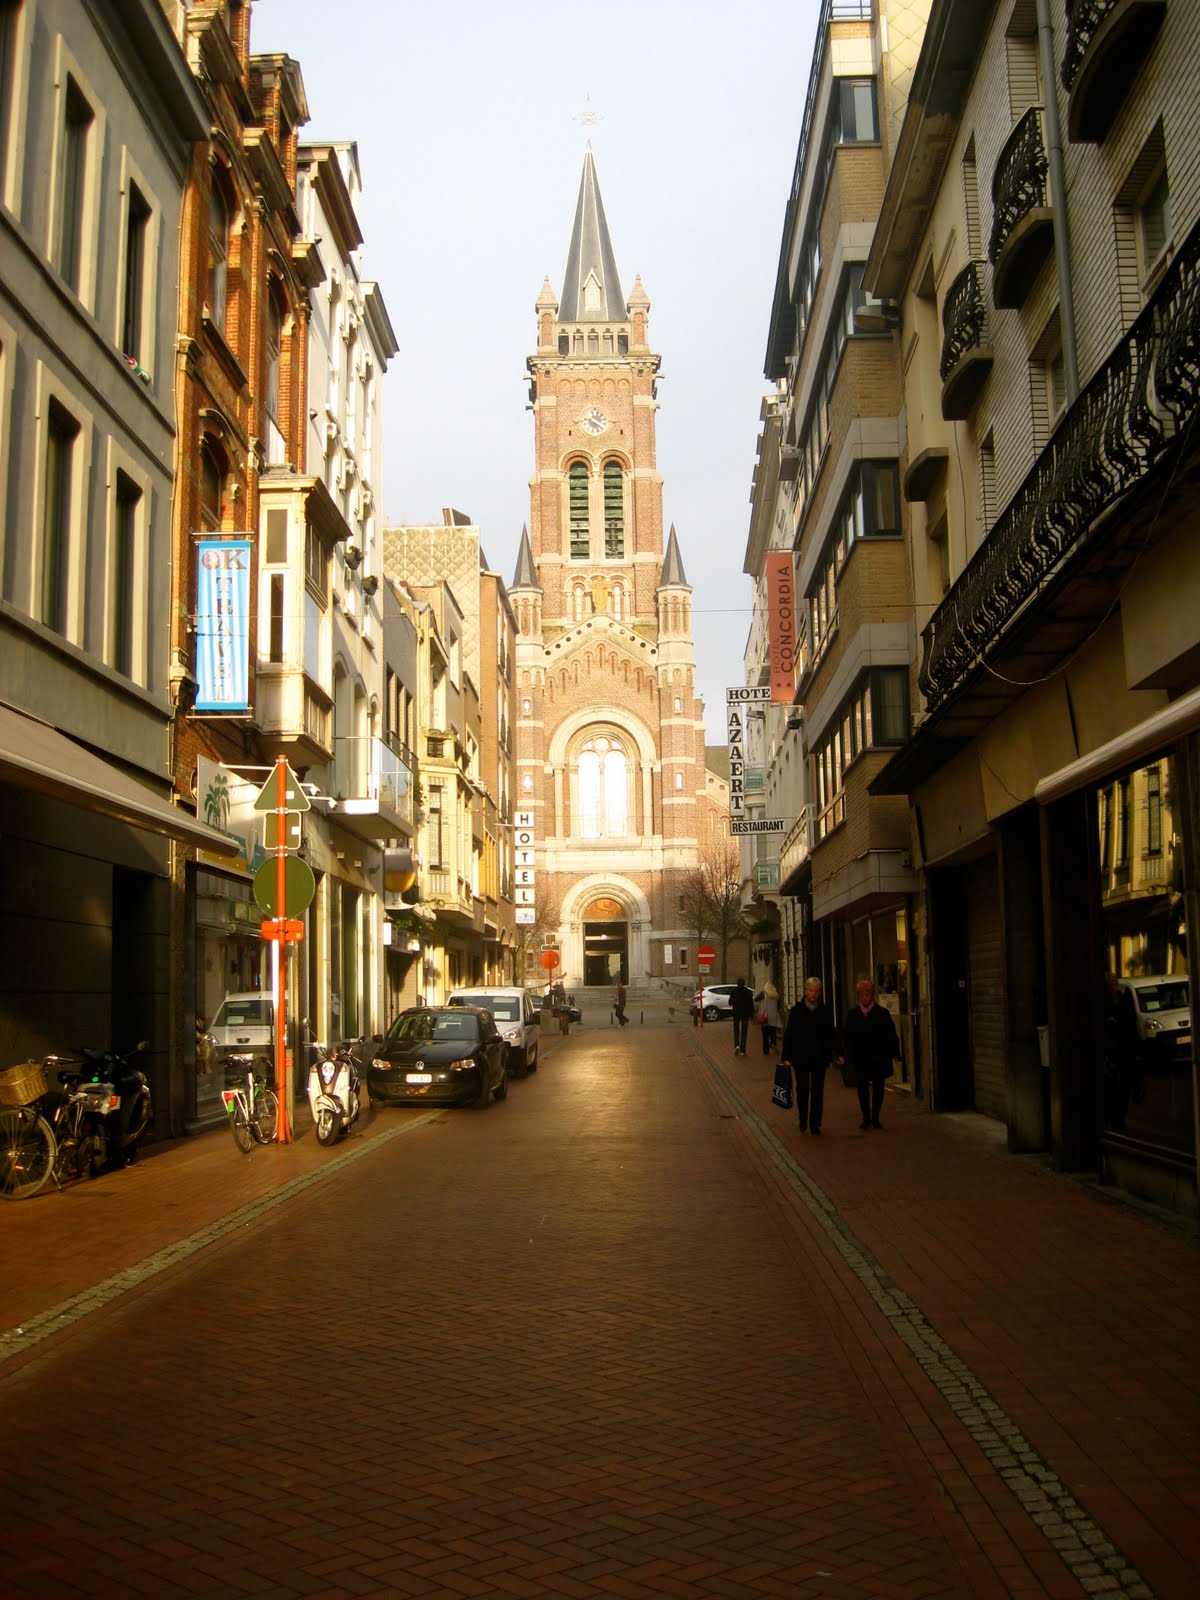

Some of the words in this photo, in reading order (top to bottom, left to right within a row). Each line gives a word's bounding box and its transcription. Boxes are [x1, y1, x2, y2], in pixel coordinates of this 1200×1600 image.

[202, 549, 247, 570] OK
[213, 577, 233, 701] TRAVEL
[778, 566, 793, 673] CONCORDIA
[729, 688, 771, 700] HOTE
[729, 712, 743, 809] AZAERT
[520, 814, 530, 901] HOTEL
[732, 820, 785, 833] RESTAURANT
